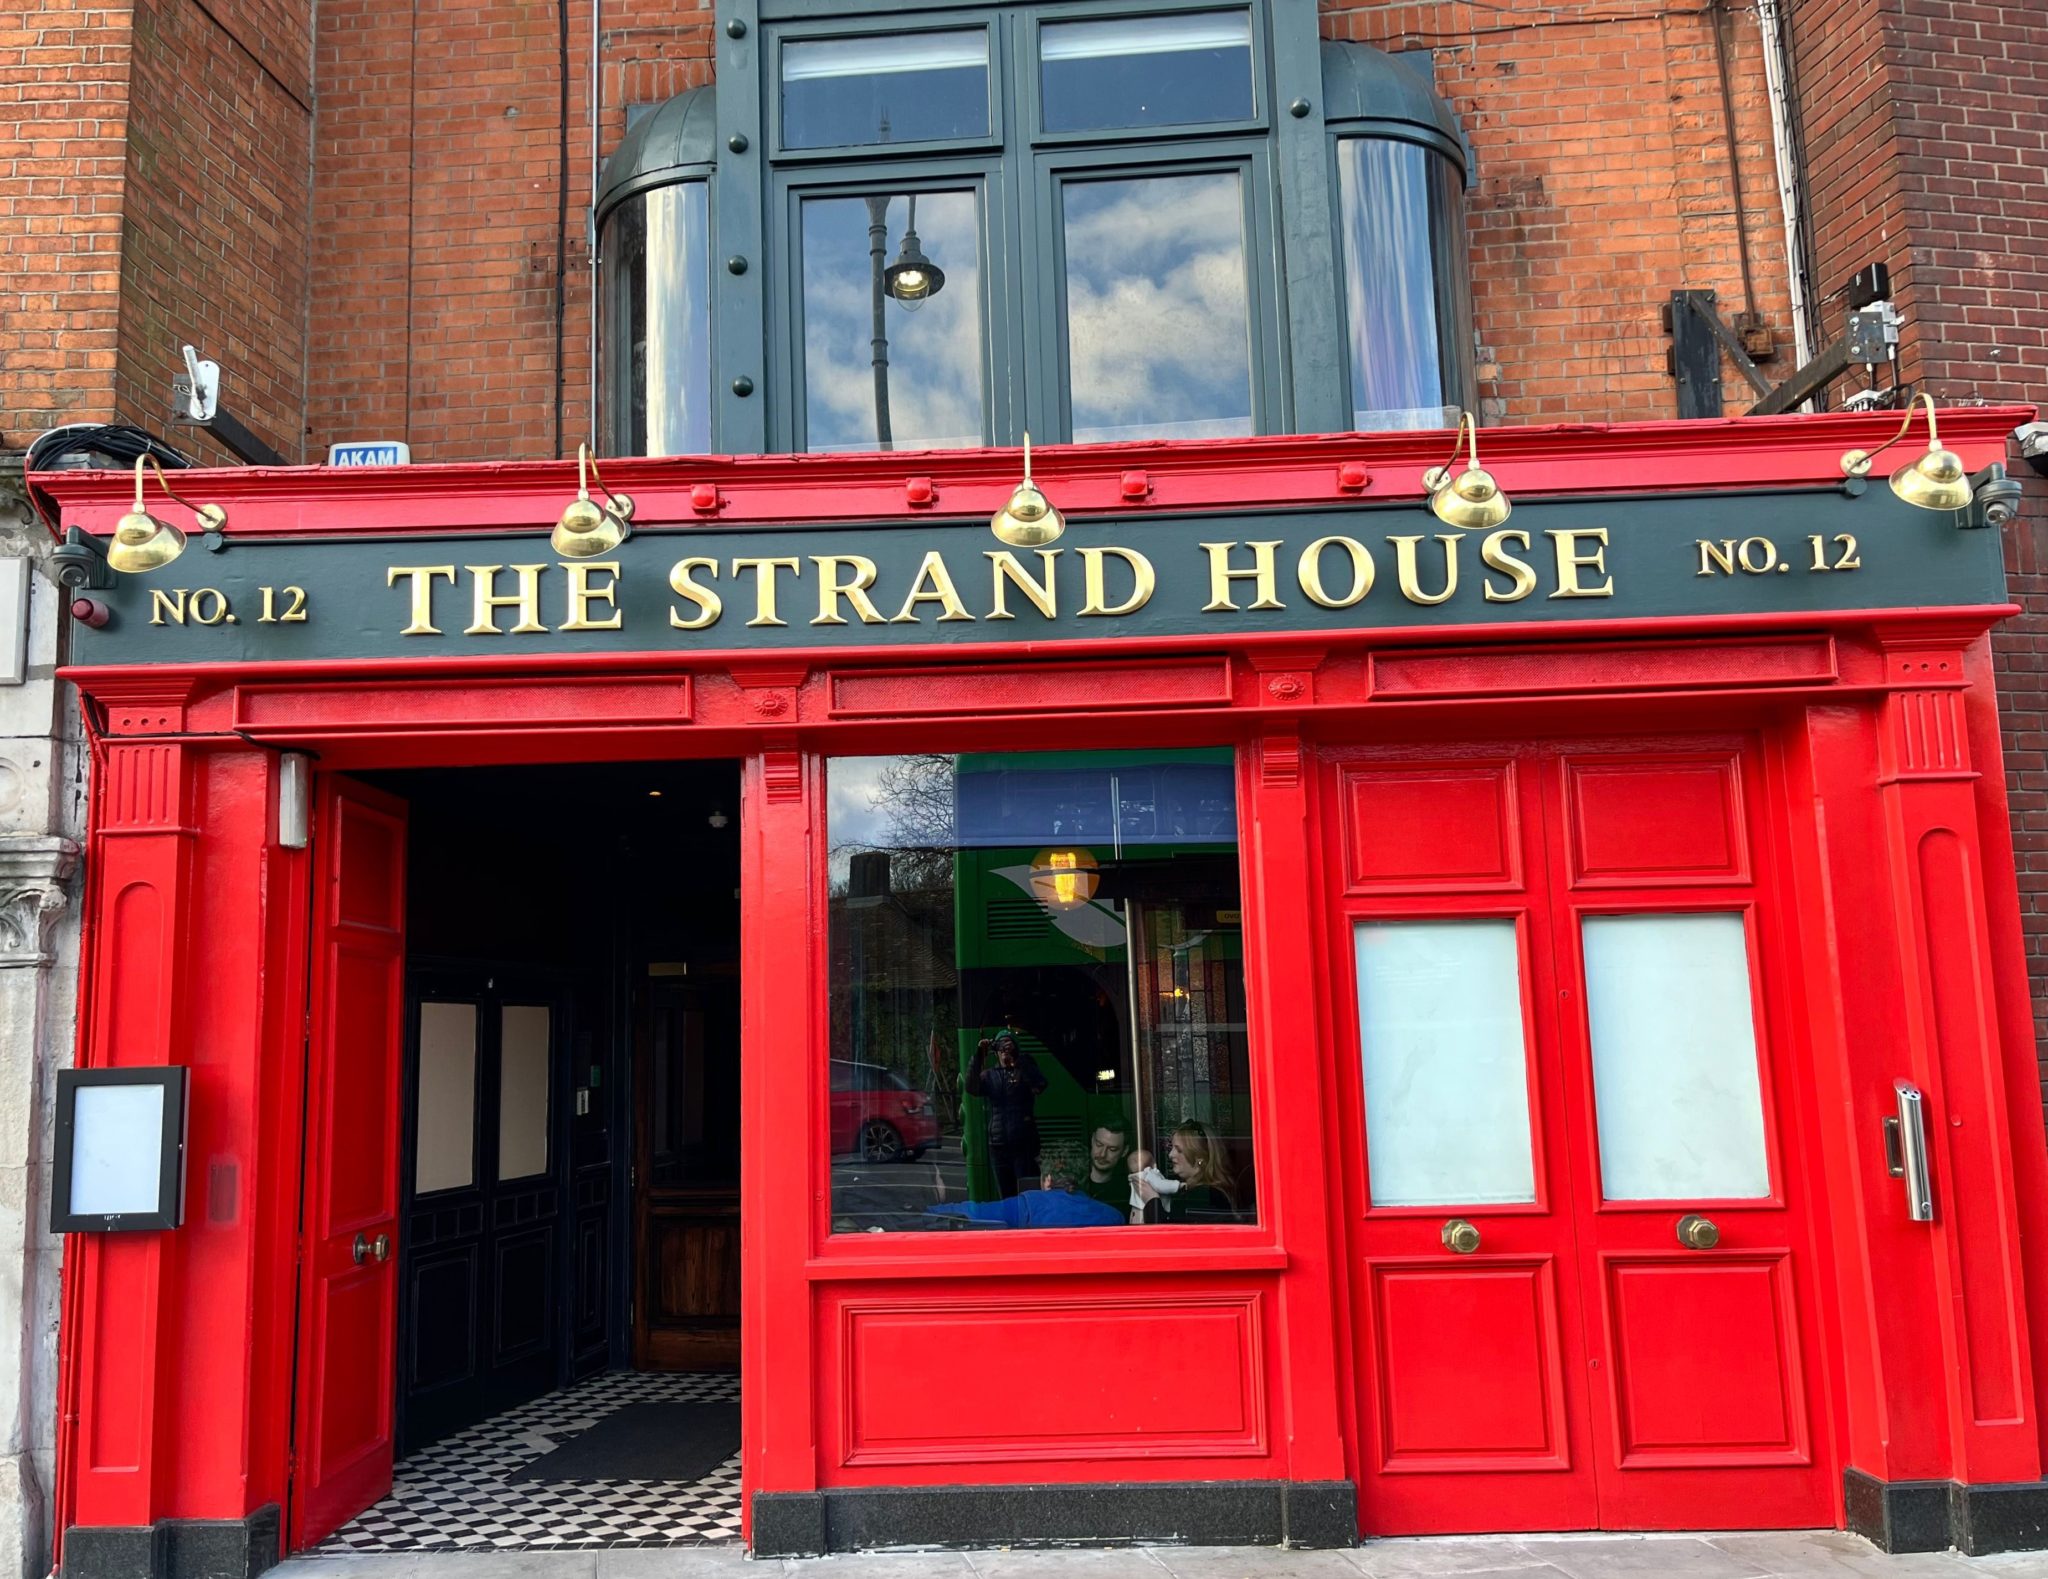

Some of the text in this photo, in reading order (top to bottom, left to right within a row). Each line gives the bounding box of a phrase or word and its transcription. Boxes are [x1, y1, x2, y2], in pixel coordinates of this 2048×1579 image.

[338, 449, 394, 466] AKAM
[1696, 534, 1861, 575] NO. 12
[387, 528, 1614, 635] THE STRAND HOUSE
[149, 586, 307, 625] NO. 12
